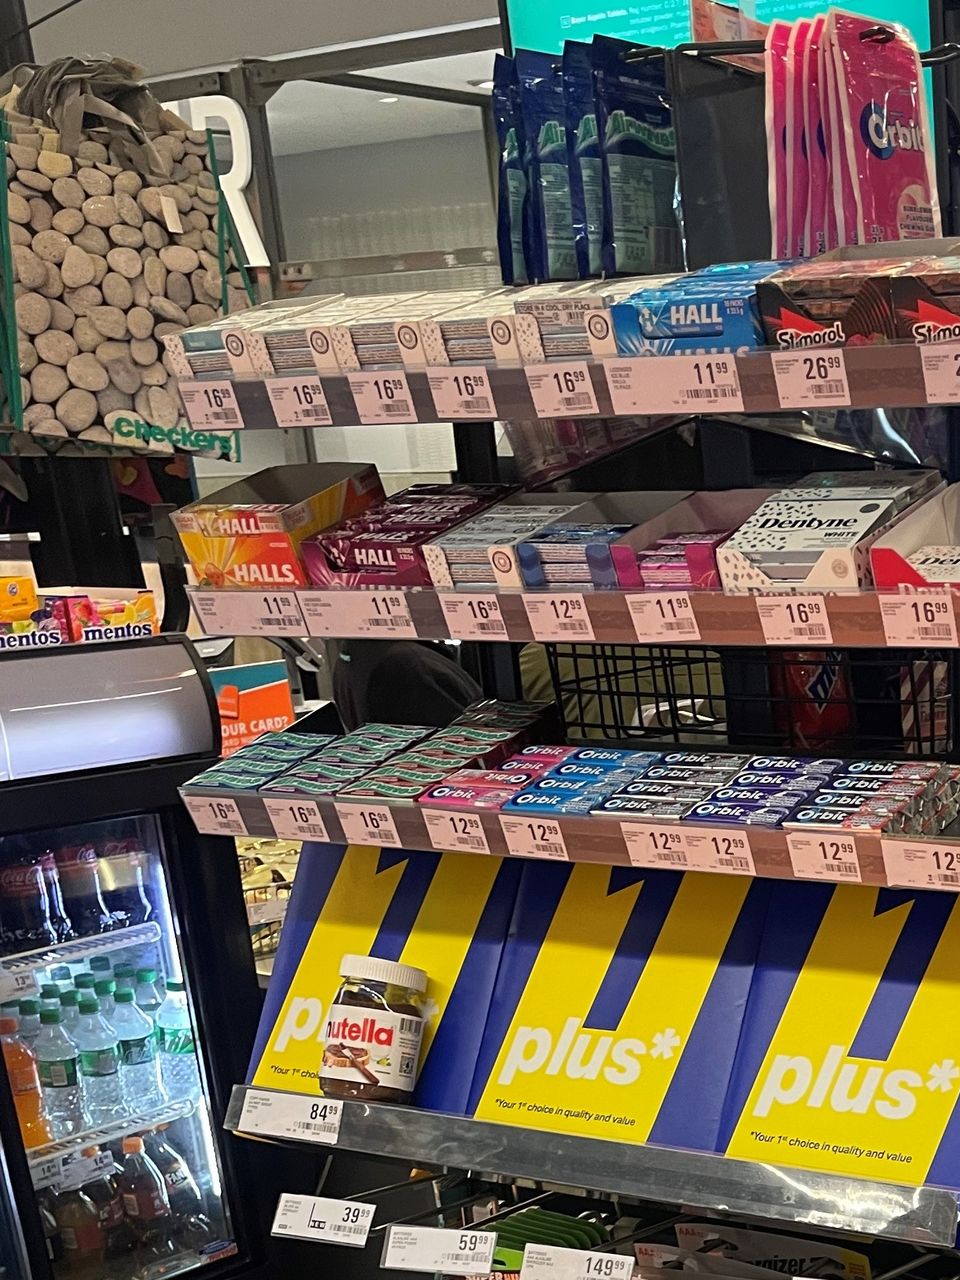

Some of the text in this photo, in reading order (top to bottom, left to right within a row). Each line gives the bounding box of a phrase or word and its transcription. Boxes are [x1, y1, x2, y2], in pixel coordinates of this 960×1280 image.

[867, 110, 926, 153] Orbit
[671, 303, 723, 326] HALL
[114, 417, 234, 454] Checkers
[219, 518, 260, 536] HALL
[758, 515, 858, 531] Dentyne
[354, 548, 396, 566] HALL
[84, 622, 152, 642] mentos
[249, 715, 289, 734] CARD?
[521, 745, 564, 756] Orbit
[577, 749, 622, 761] Orbit
[664, 752, 712, 763] Orbit
[752, 757, 801, 770] Orbit
[501, 760, 544, 771] Orbit
[559, 763, 604, 776] Orbit
[847, 761, 898, 774] Orbit
[647, 767, 695, 779] Orbit
[737, 773, 785, 786] Orbit
[540, 777, 584, 790] Orbit
[626, 782, 675, 794] Orbit
[832, 777, 883, 790] Orbit
[432, 787, 475, 799] Orbit
[516, 793, 561, 806] Orbit
[715, 788, 765, 801] Orbit
[814, 793, 866, 806] Orbit
[604, 798, 653, 810] Orbit
[695, 804, 745, 817] Orbit
[796, 809, 848, 822] Orbit
[325, 1018, 395, 1049] nutella
[527, 1102, 555, 1116] choice
[555, 1106, 563, 1116] in
[564, 1106, 593, 1124] quality
[594, 1110, 612, 1122] and
[612, 1113, 637, 1127] value
[788, 1136, 821, 1151] choice
[821, 1140, 831, 1152] in
[832, 1143, 866, 1161] quality
[866, 1147, 884, 1161] and
[885, 1149, 913, 1165] value
